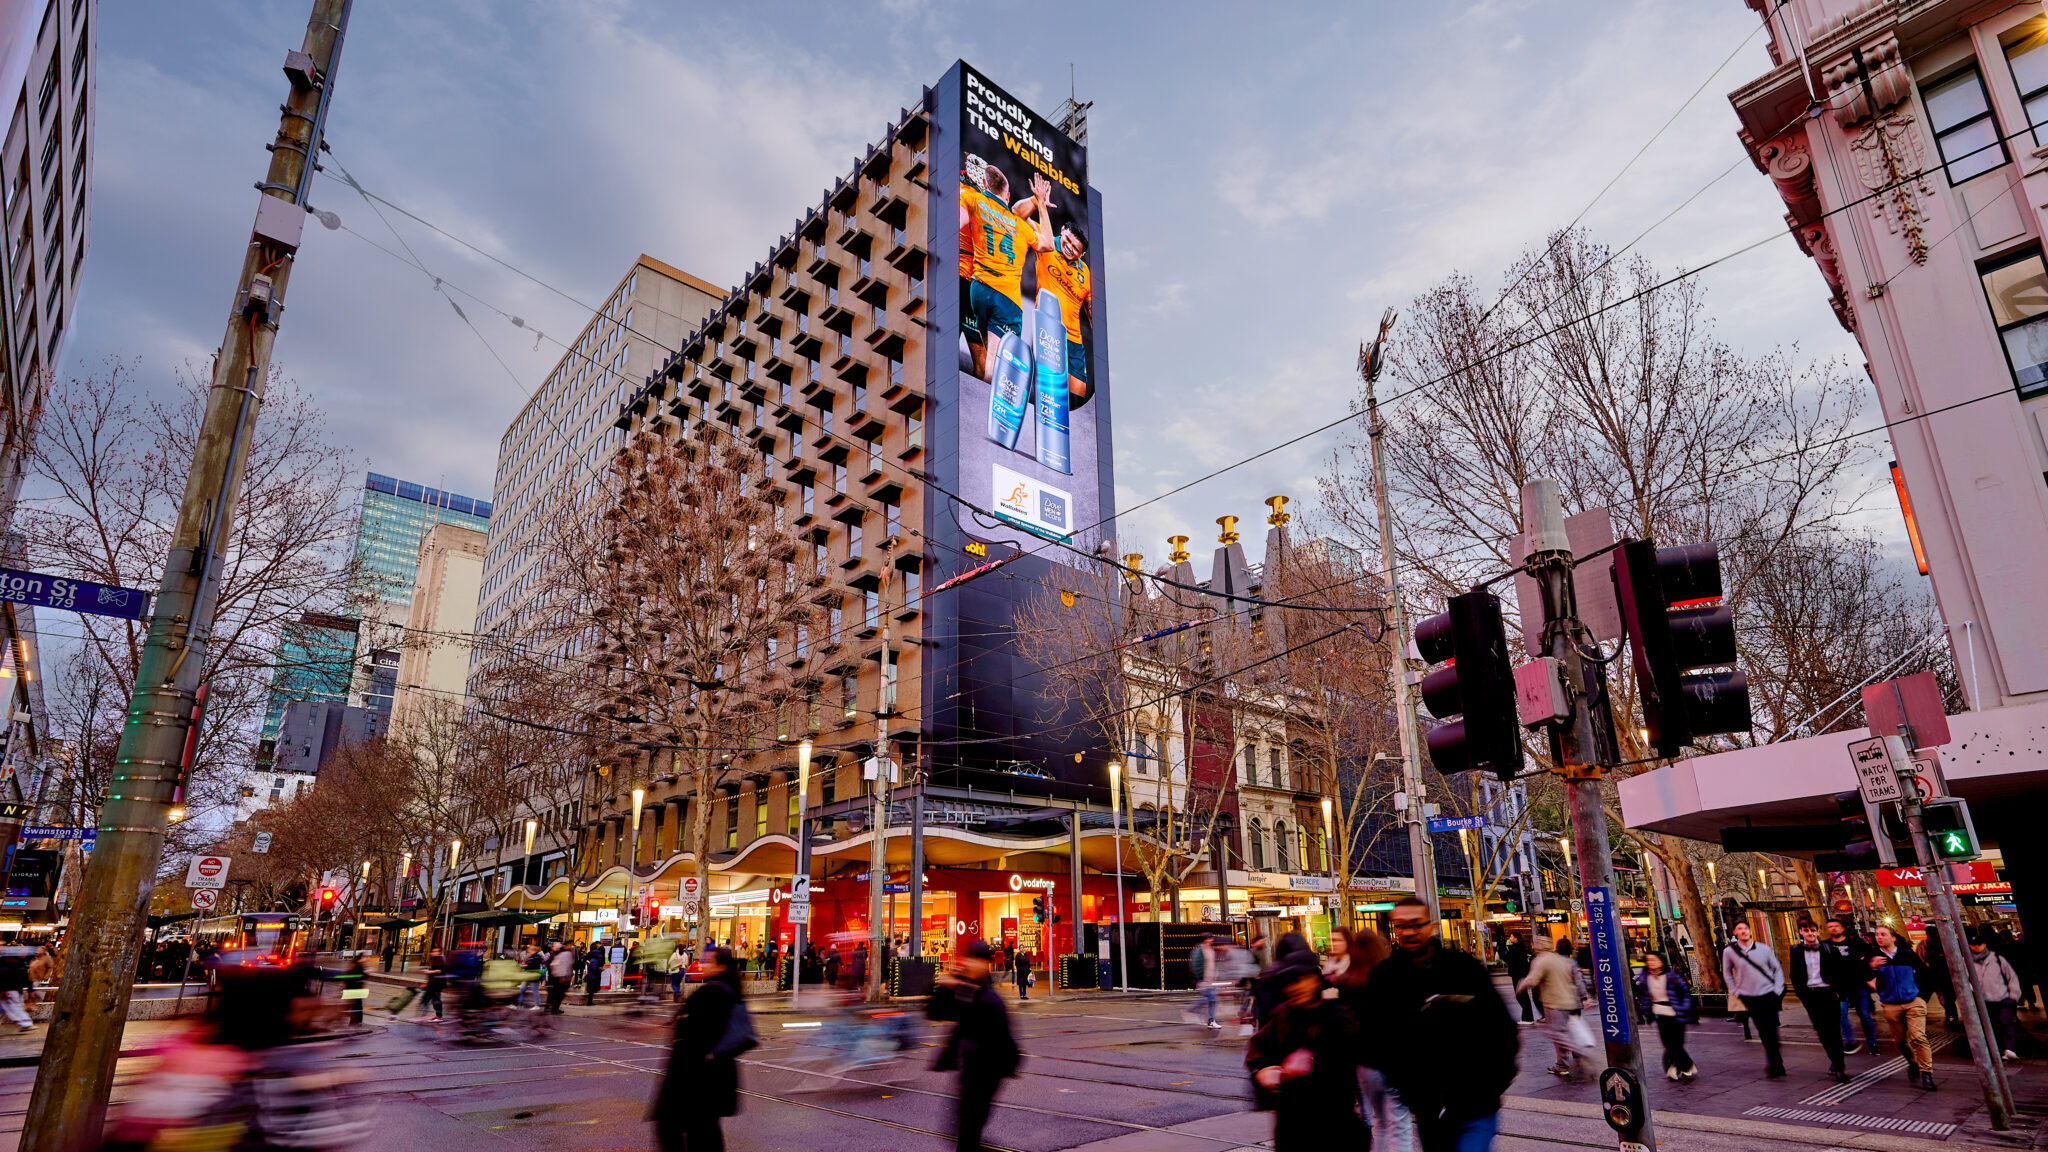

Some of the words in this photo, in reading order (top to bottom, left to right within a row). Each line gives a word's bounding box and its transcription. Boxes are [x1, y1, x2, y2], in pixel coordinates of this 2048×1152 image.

[967, 72, 1032, 130] Proudly
[967, 89, 1053, 162] Protecting
[966, 107, 999, 140] The
[1003, 131, 1080, 195] Wallabies
[983, 223, 1016, 265] 14
[1000, 502, 1027, 516] Wallabies
[50, 579, 78, 599] St
[48, 596, 74, 608] 179
[1861, 763, 1888, 777] WATCH
[1870, 776, 1887, 786] FOR
[1869, 785, 1895, 798] TRAMS
[1447, 818, 1472, 827] Bourke
[1474, 816, 1484, 824] St
[24, 826, 71, 836] Swanston
[1023, 878, 1055, 888] vodafone
[1594, 906, 1604, 924] 352
[1597, 932, 1608, 950] 270
[1598, 958, 1611, 972] St
[1602, 975, 1619, 1023] Bourke
